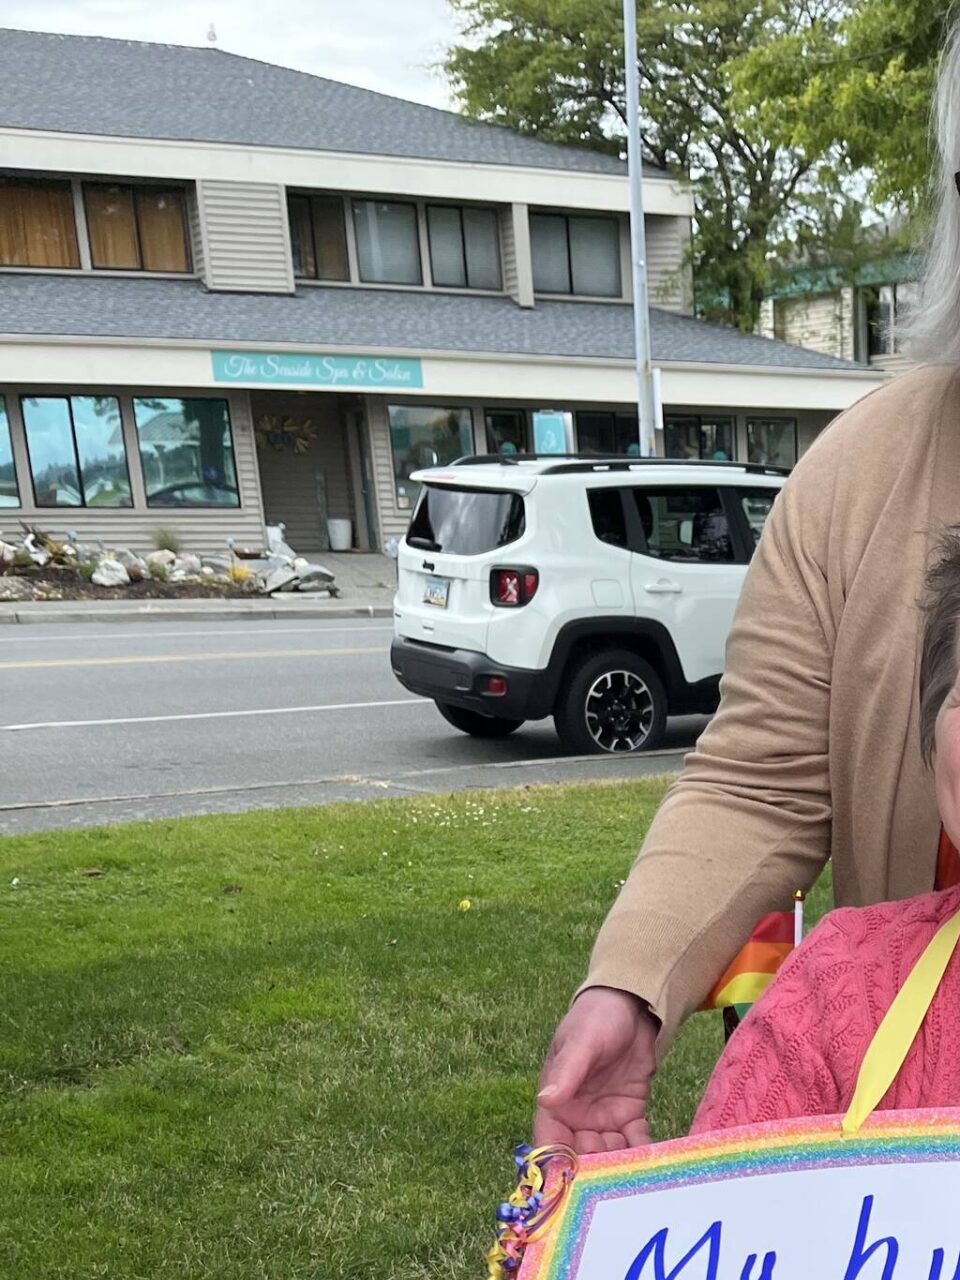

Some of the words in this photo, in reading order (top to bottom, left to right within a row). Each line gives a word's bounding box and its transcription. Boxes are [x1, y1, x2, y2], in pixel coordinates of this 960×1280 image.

[223, 355, 256, 377] The
[260, 356, 313, 379] Seaside
[316, 357, 348, 384] Spa
[352, 361, 365, 380] &
[368, 358, 411, 382] Salon
